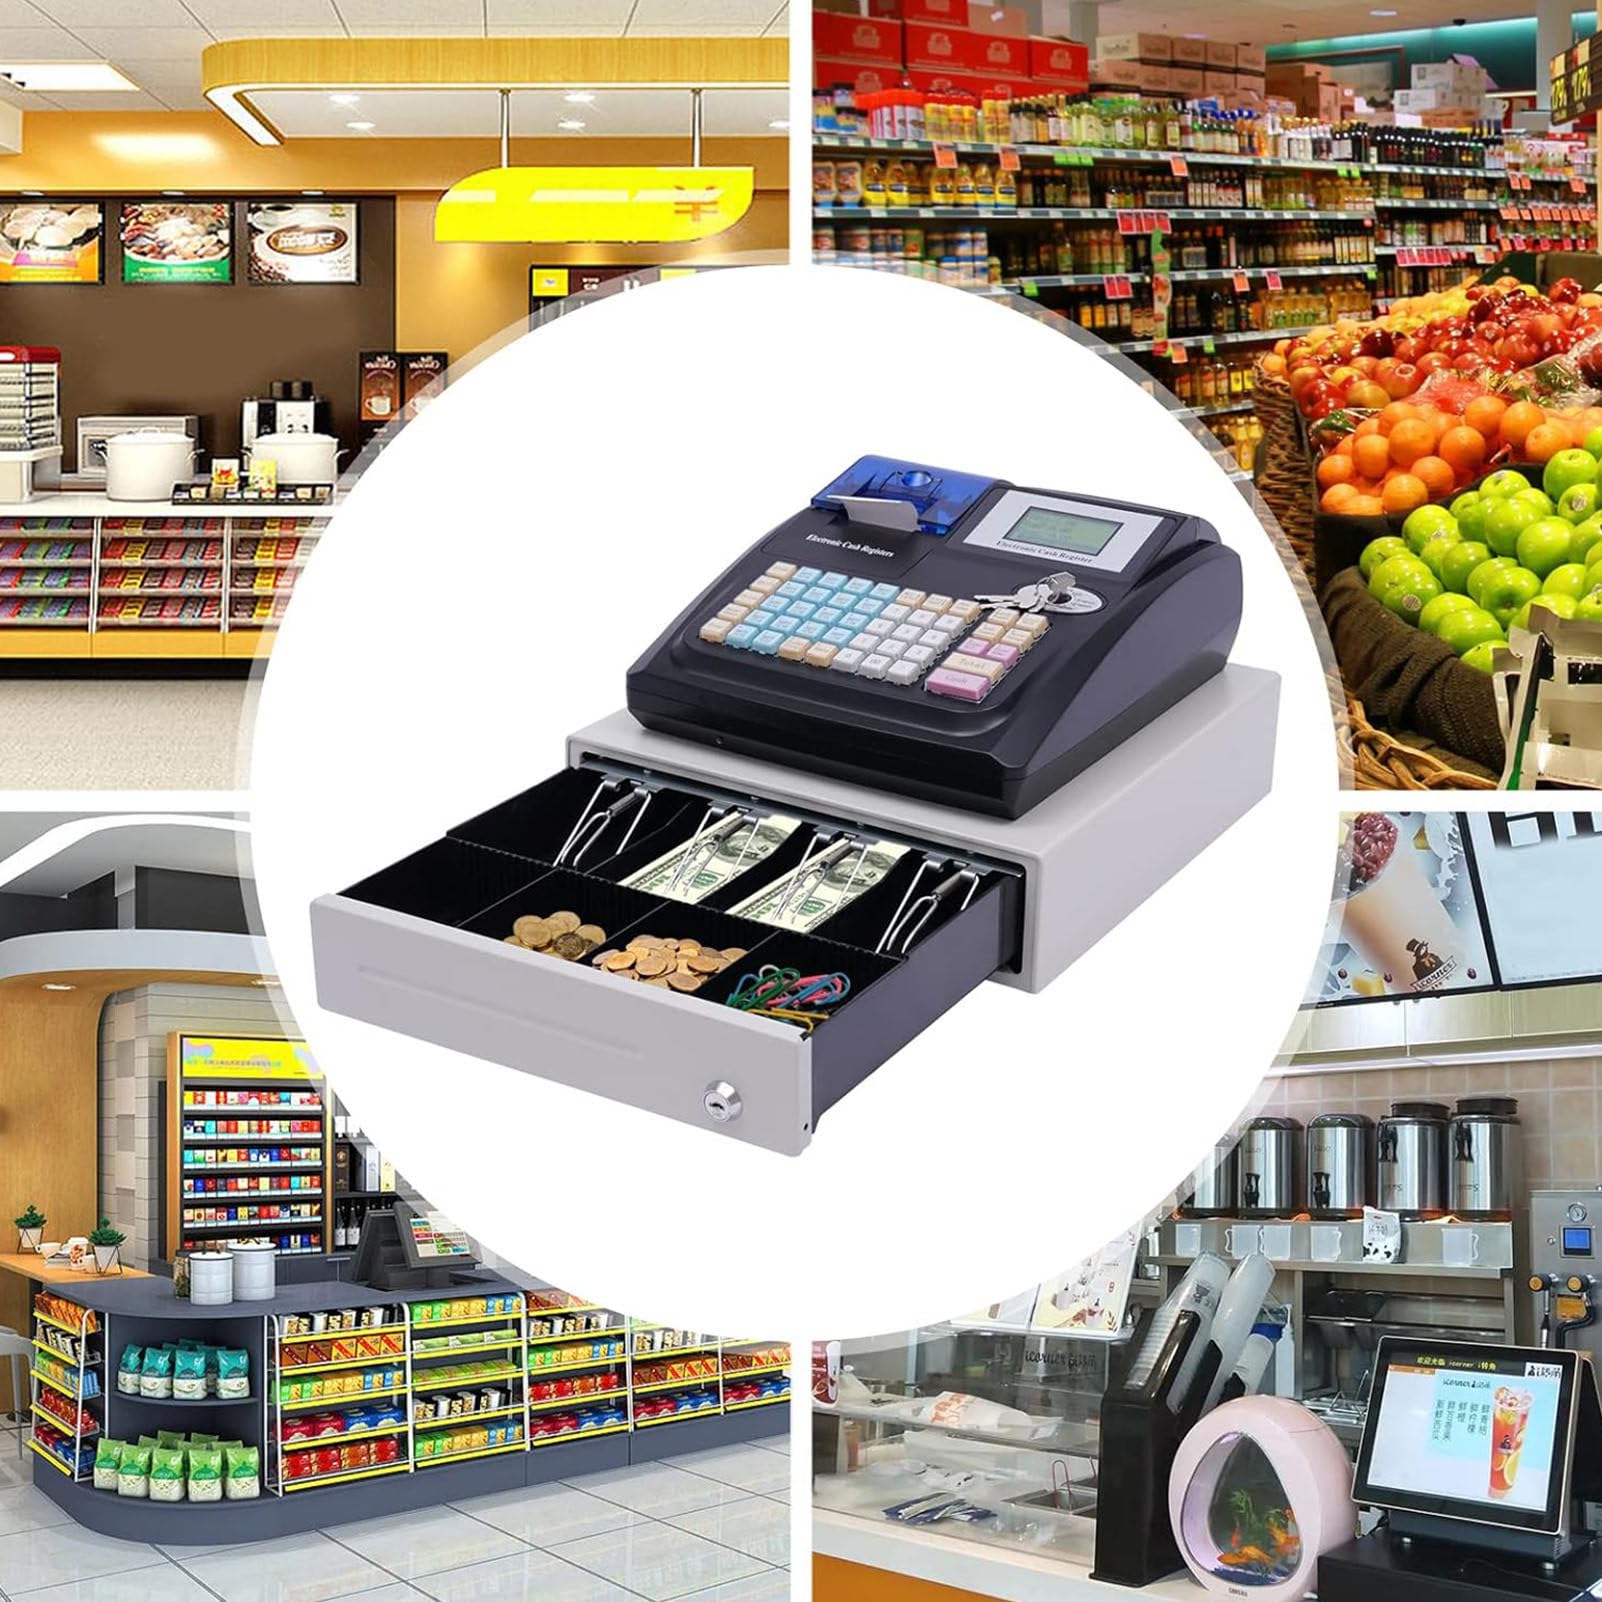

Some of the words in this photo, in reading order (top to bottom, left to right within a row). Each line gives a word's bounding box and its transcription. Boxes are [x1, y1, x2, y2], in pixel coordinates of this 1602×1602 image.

[805, 533, 842, 547] Electronic
[842, 540, 861, 551] Cash
[860, 544, 895, 558] Registers
[996, 540, 1037, 554] Electronic
[1037, 548, 1058, 559] Cash
[1058, 552, 1093, 564] Register
[959, 658, 985, 669] Total
